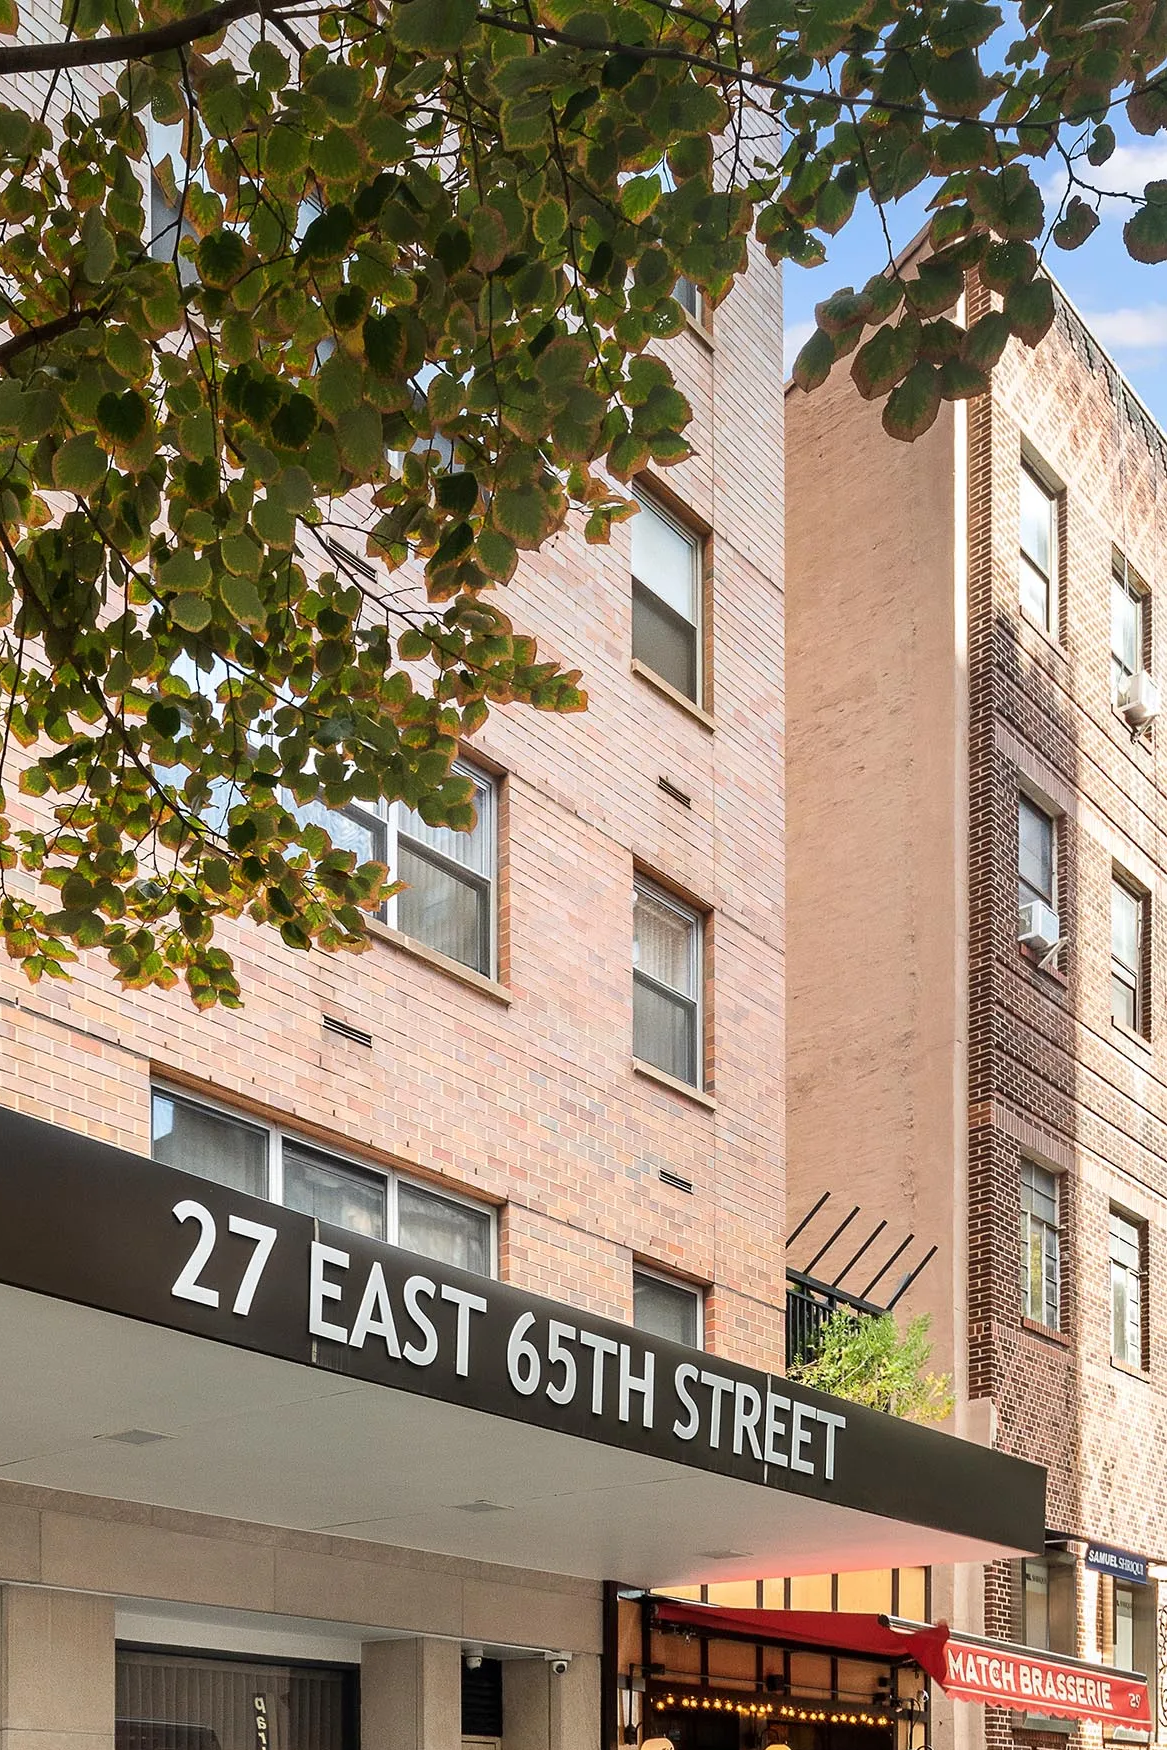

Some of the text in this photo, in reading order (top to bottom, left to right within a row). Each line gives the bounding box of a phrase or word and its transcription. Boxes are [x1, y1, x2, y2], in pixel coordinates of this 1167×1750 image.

[170, 1200, 846, 1480] 27 EAST 65TH STREET
[1088, 1550, 1118, 1568] SAMUEL
[947, 1648, 1114, 1710] MATCH BRASSERIE
